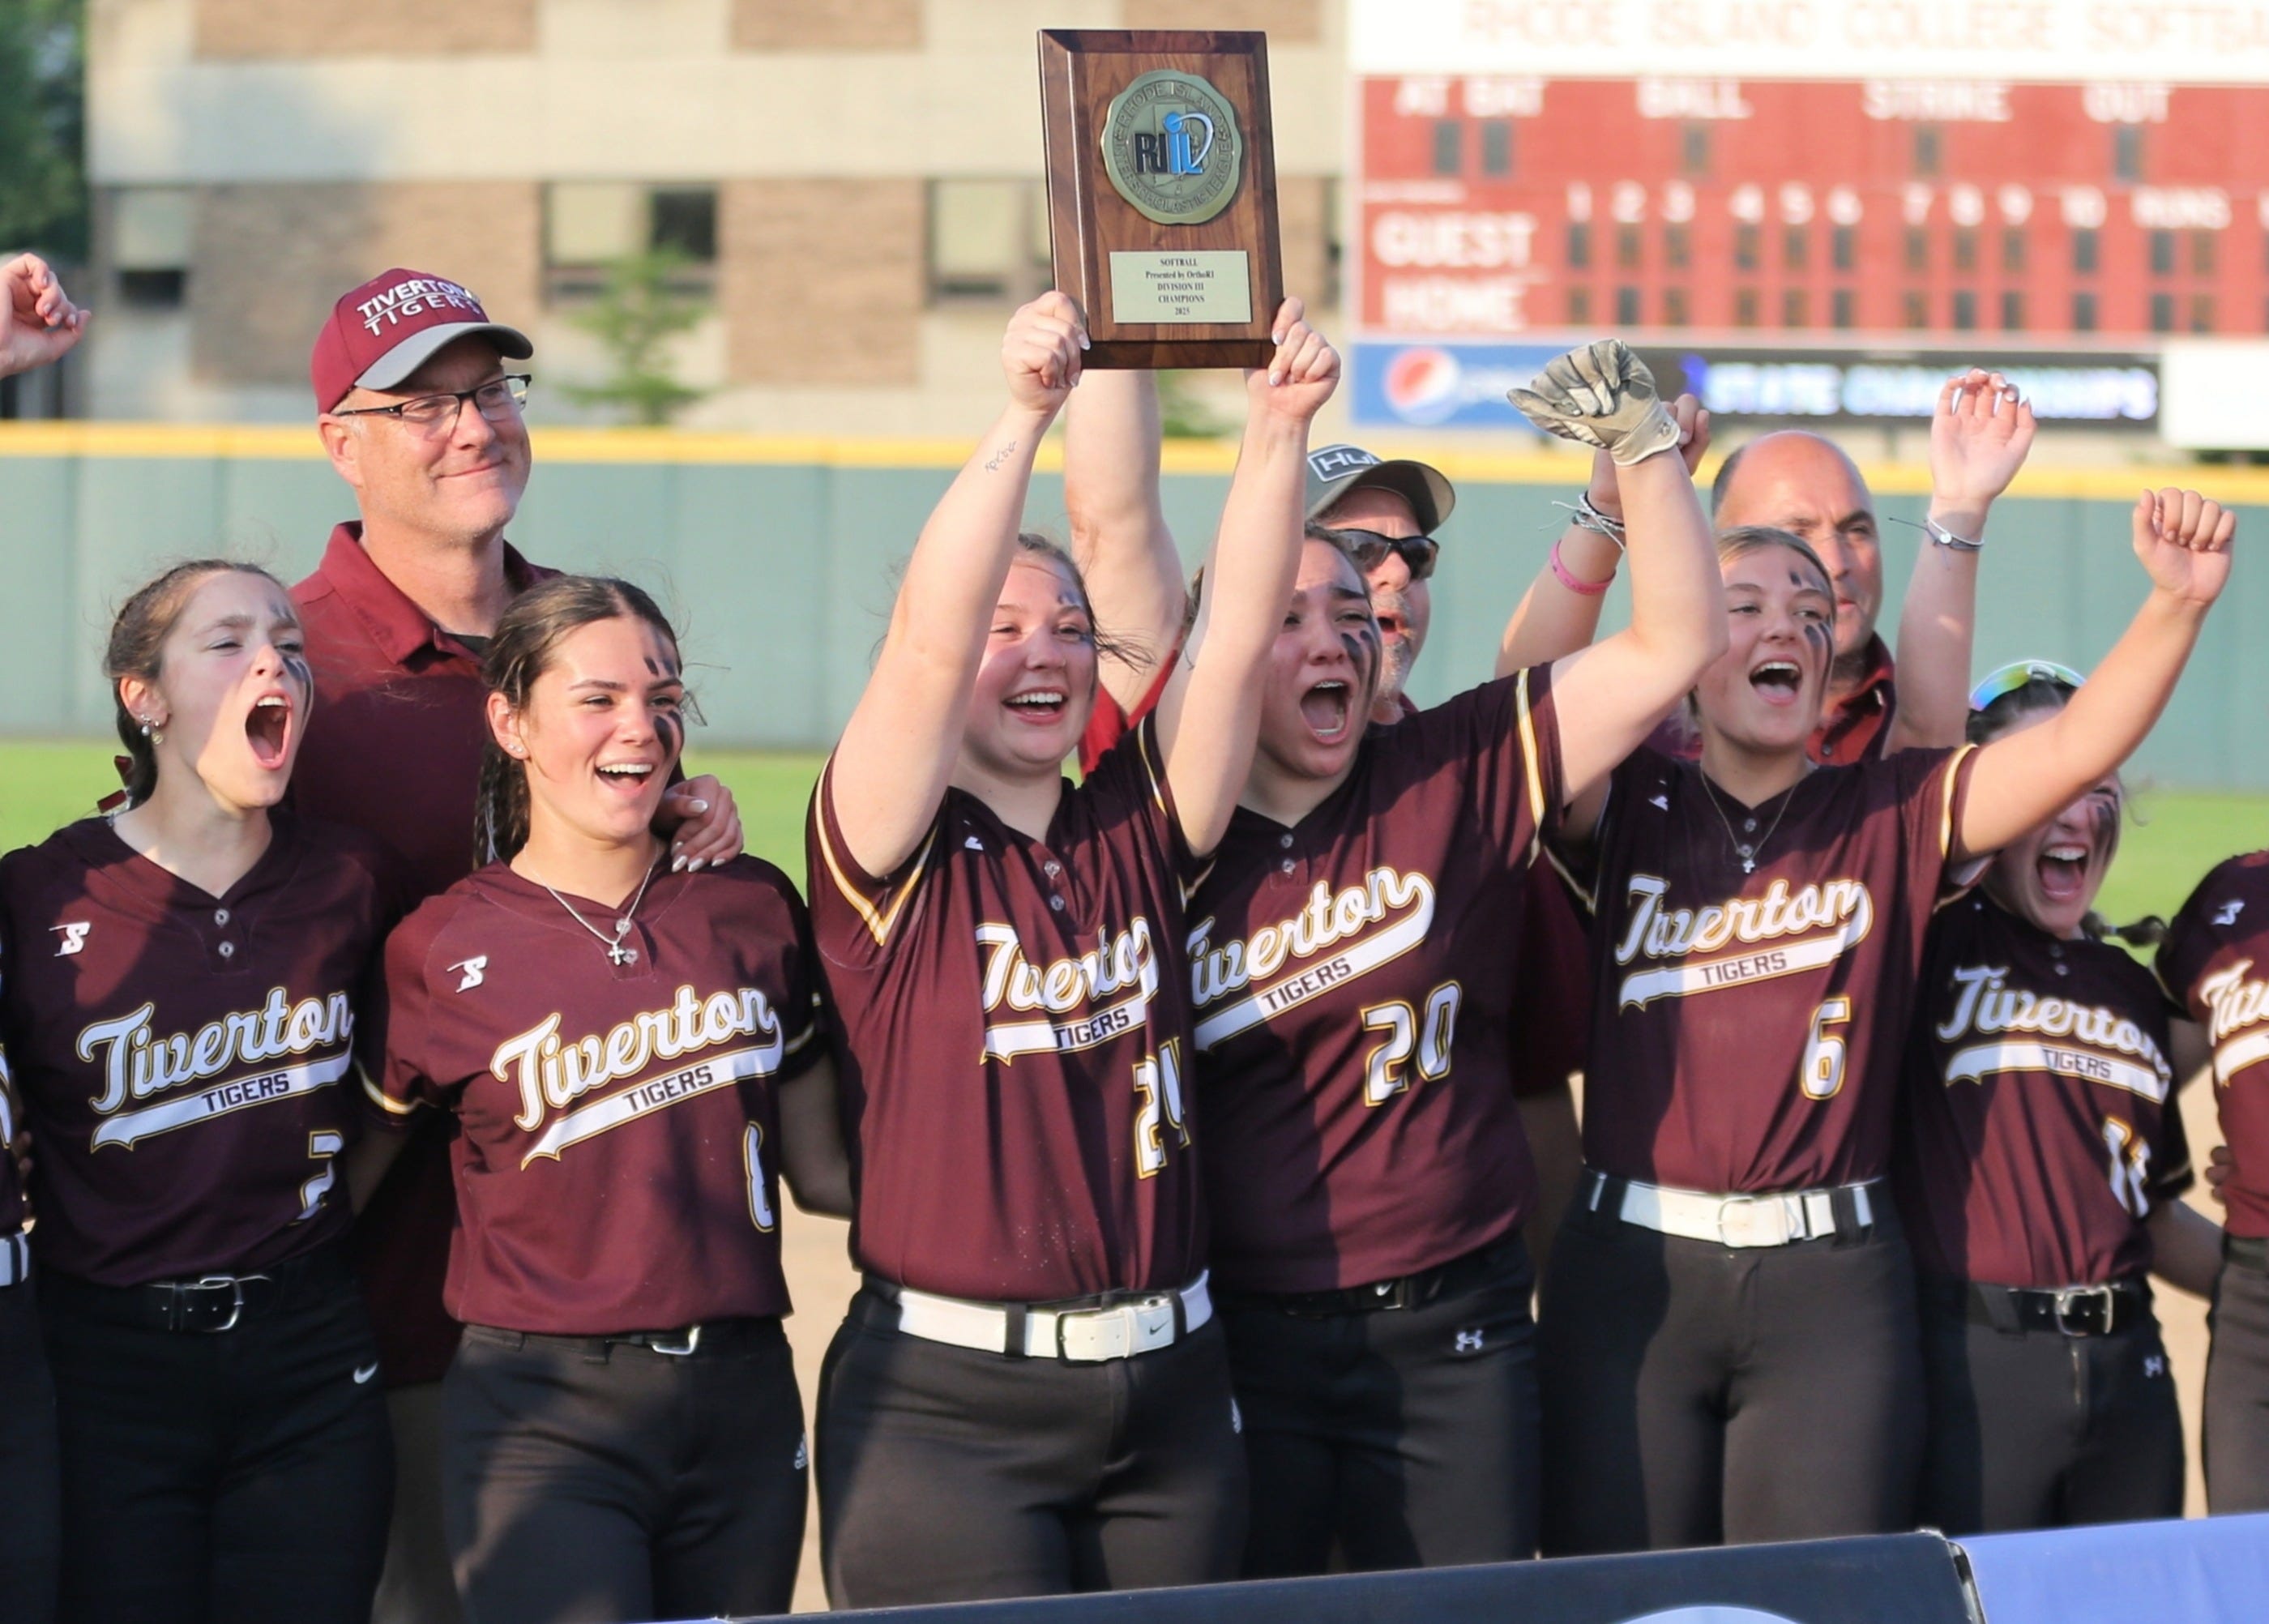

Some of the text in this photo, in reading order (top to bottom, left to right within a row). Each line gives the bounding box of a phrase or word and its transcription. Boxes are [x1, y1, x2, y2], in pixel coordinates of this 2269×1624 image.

[1117, 83, 1166, 125] RHODE
[1373, 212, 1538, 267] GUEST
[1145, 270, 1177, 279] Presented
[1177, 271, 1186, 282] by
[1160, 258, 1199, 267] SOFTBALL
[357, 279, 476, 319] TIVERTON
[1157, 282, 1204, 291] DIVISION III
[1158, 294, 1205, 303] CHAMPIONS
[365, 294, 481, 337] TIGERS
[1186, 866, 1433, 1009] iverton
[1261, 956, 1352, 1012] TIGERS
[1700, 951, 1788, 985] TIGERS
[1053, 1007, 1130, 1049] TIGERS
[1361, 980, 1463, 1108] 20
[1801, 994, 1852, 1101] 6
[77, 987, 355, 1115] Tiverton
[489, 984, 780, 1132] Tiverton
[2042, 1047, 2112, 1080] TIGERS
[202, 1072, 289, 1113] TIGERS
[622, 1065, 713, 1112] TIGERS
